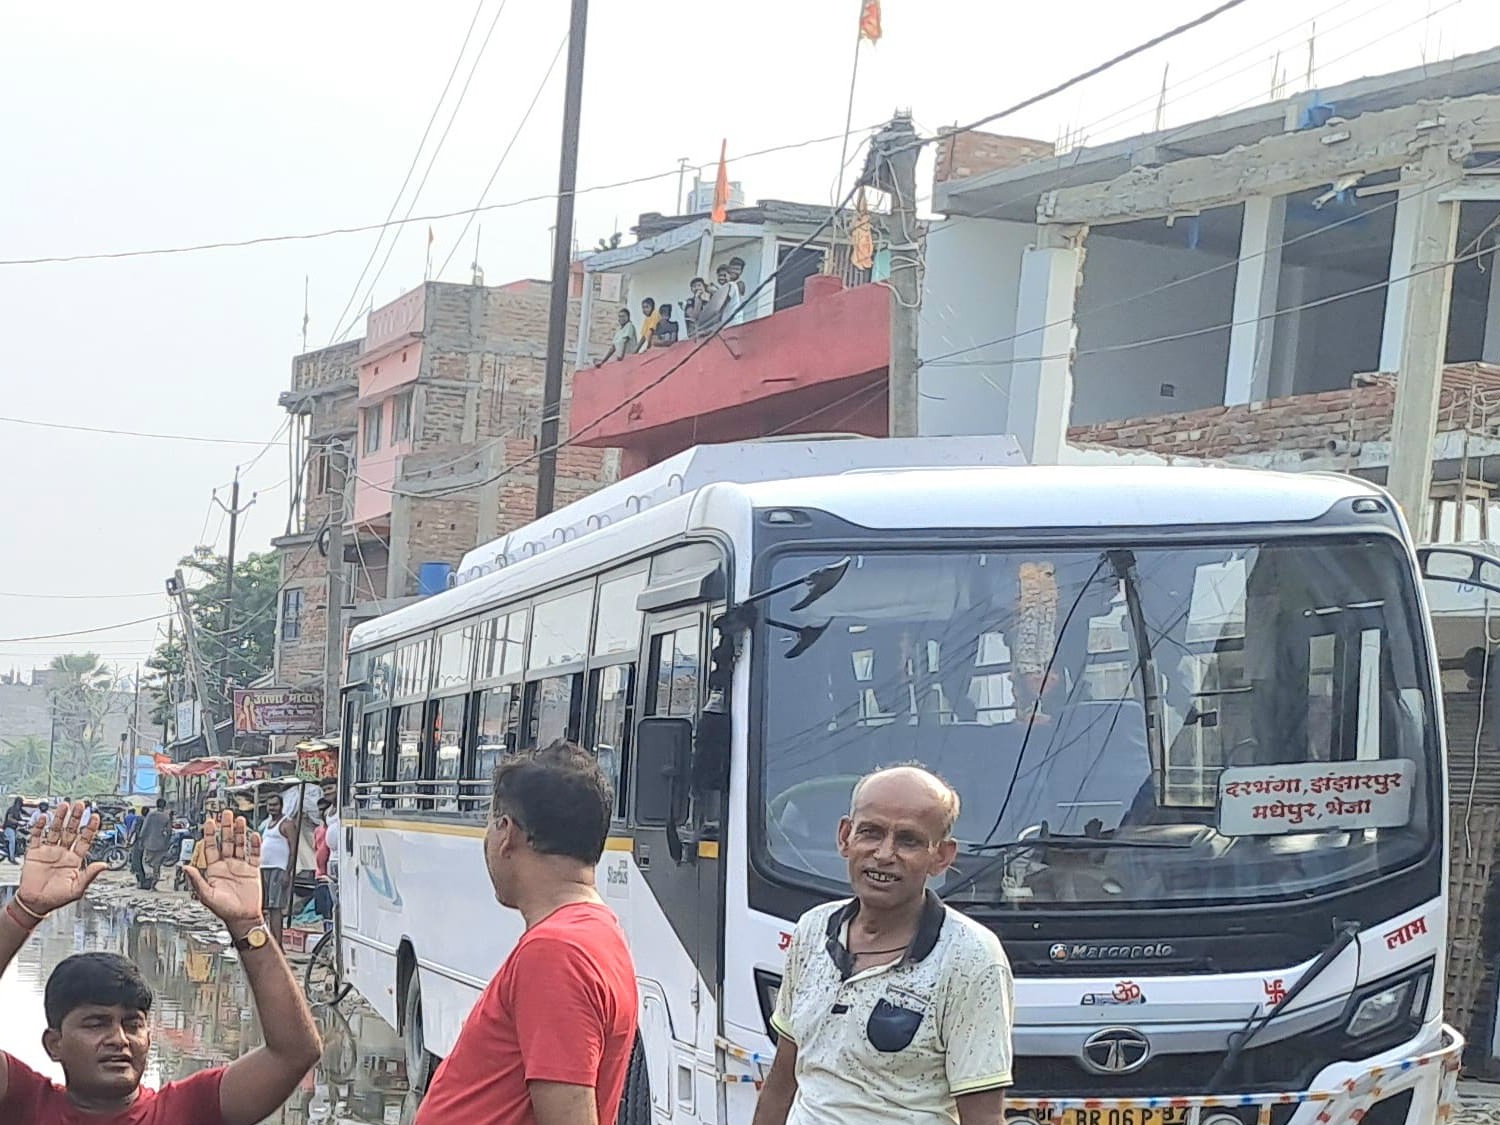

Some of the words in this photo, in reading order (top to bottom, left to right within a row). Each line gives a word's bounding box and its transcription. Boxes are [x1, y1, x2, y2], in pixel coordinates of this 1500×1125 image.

[1225, 774, 1307, 797] दरभंगा,
[1325, 796, 1372, 817] भेजा
[1382, 916, 1429, 951] लाभ
[1070, 943, 1173, 960] Marcopolo
